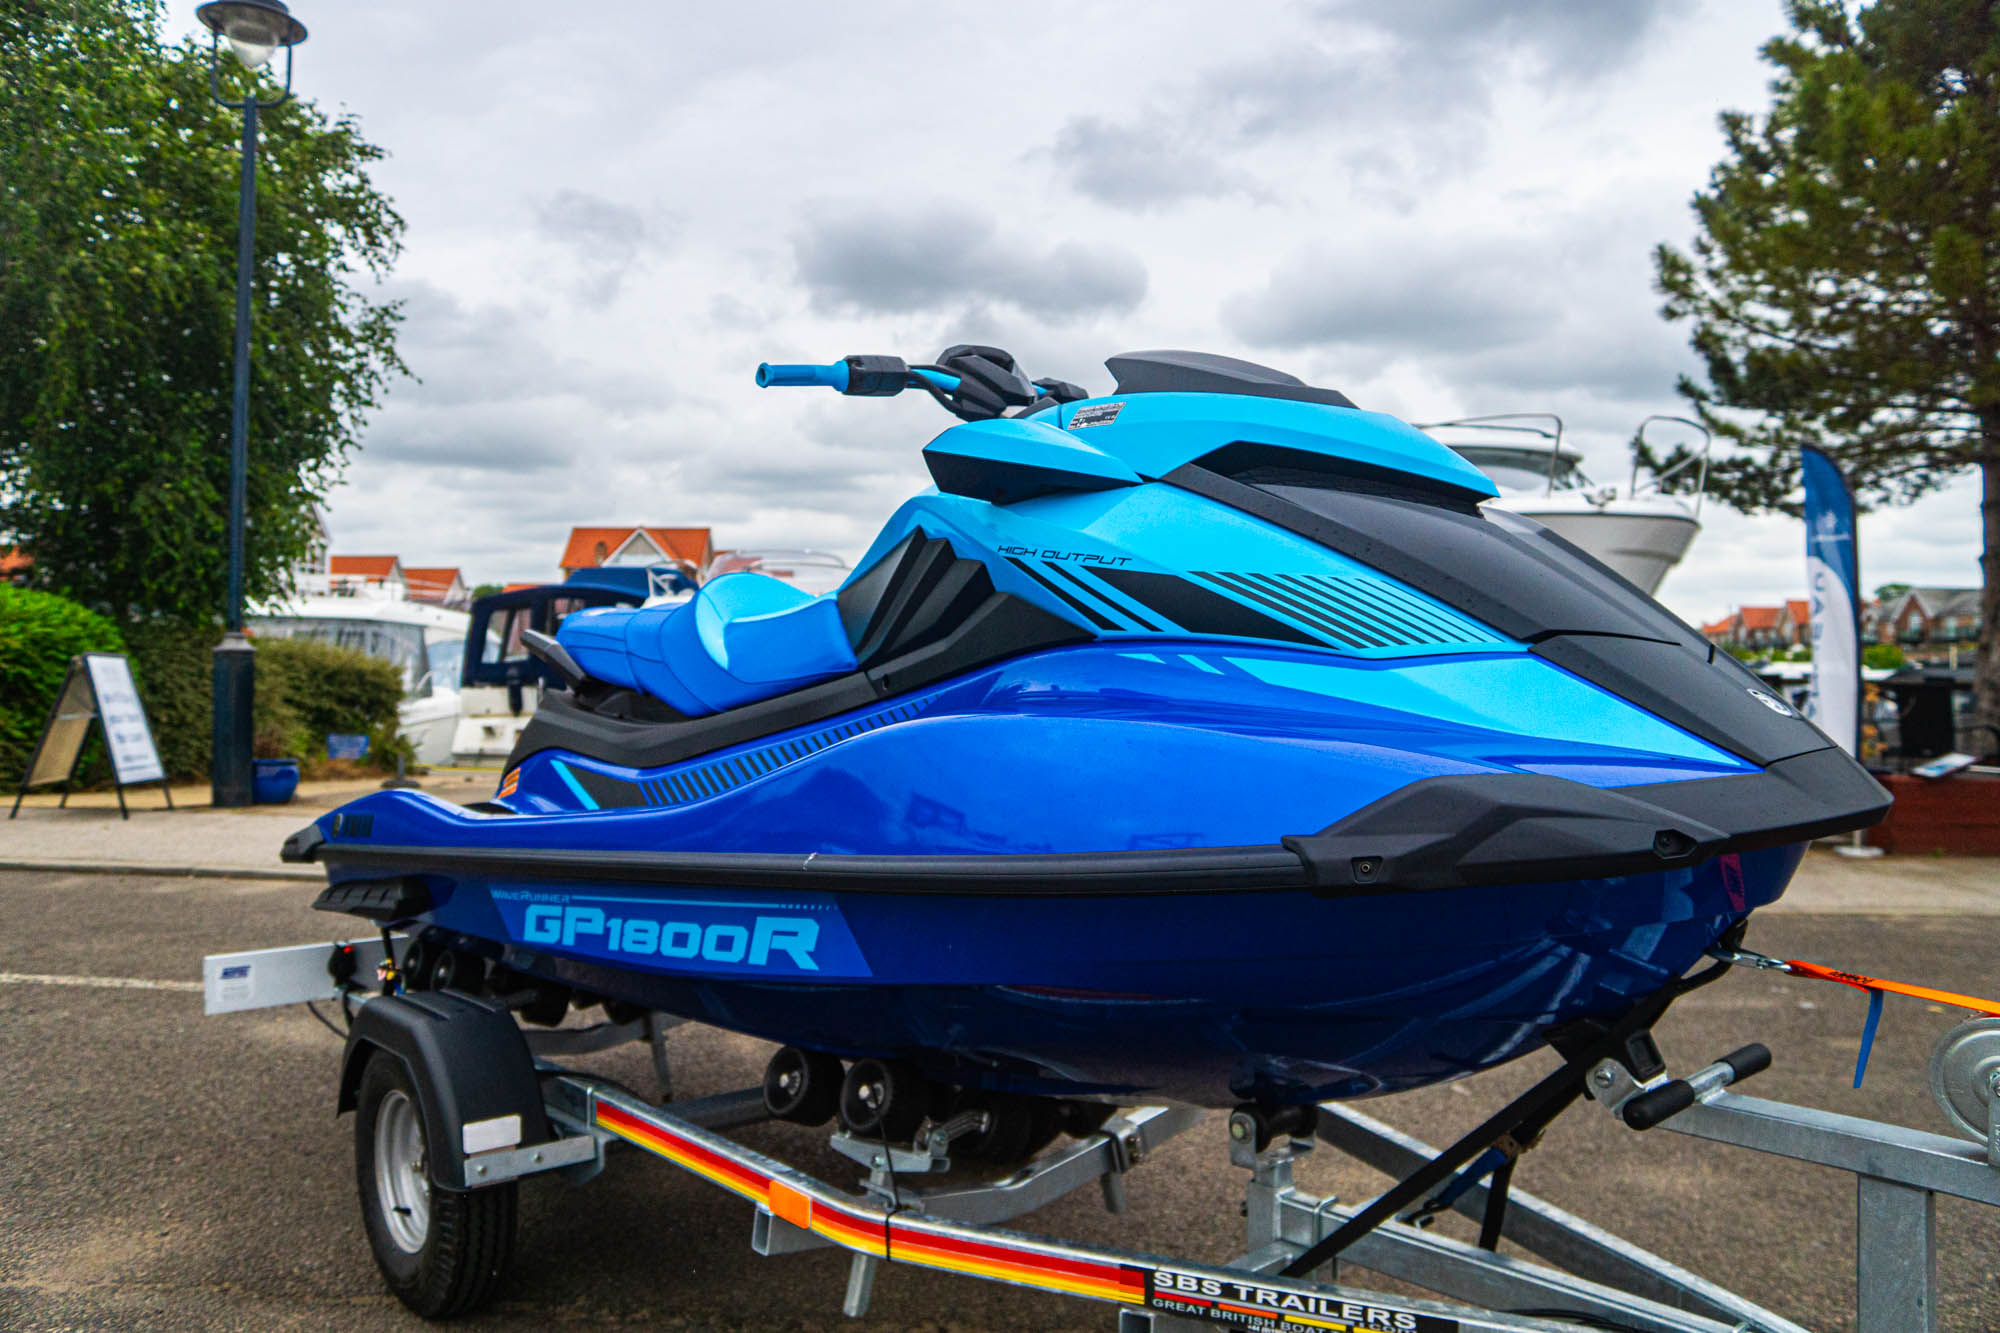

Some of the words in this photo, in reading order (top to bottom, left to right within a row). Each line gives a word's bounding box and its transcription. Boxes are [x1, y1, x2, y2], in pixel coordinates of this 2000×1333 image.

[997, 544, 1038, 557] HIGH
[1041, 549, 1133, 566] OUTPUT
[523, 904, 820, 971] GP1800R
[1152, 1299, 1207, 1315] GREAT
[1210, 1308, 1276, 1329] BRITISH
[1153, 1271, 1222, 1297] SBS
[1232, 1283, 1418, 1330] TRAILERS
